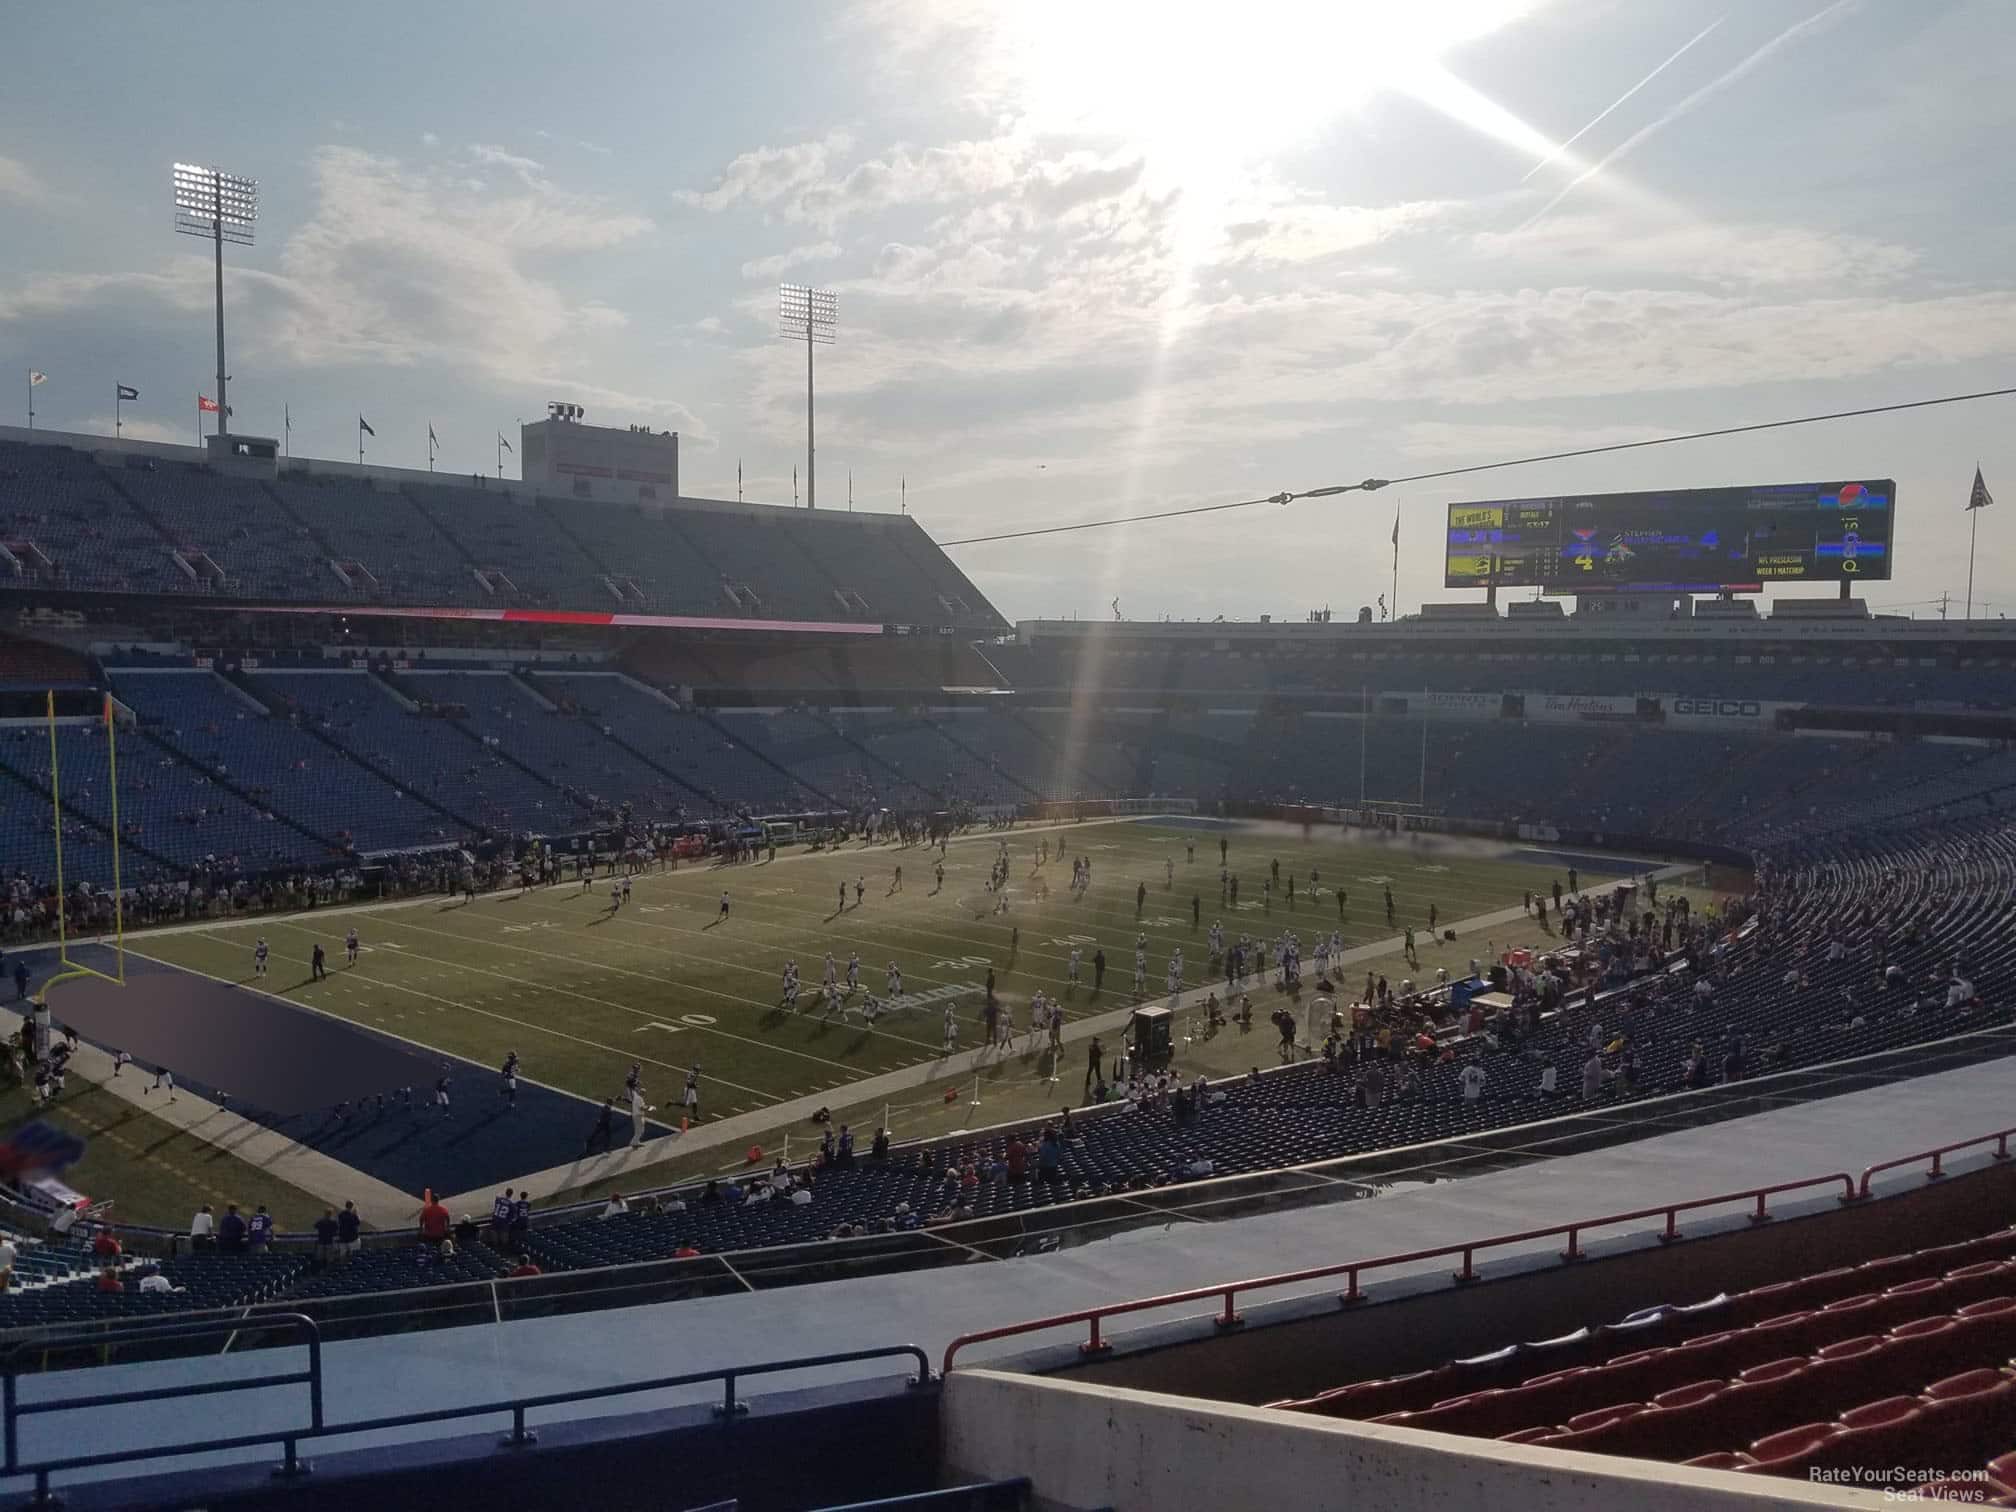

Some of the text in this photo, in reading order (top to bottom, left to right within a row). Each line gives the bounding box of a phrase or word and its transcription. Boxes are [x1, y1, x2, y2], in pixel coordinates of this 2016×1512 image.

[1674, 700, 1760, 717] GEICO
[641, 1014, 718, 1033] 10
[495, 1203, 510, 1219] 12
